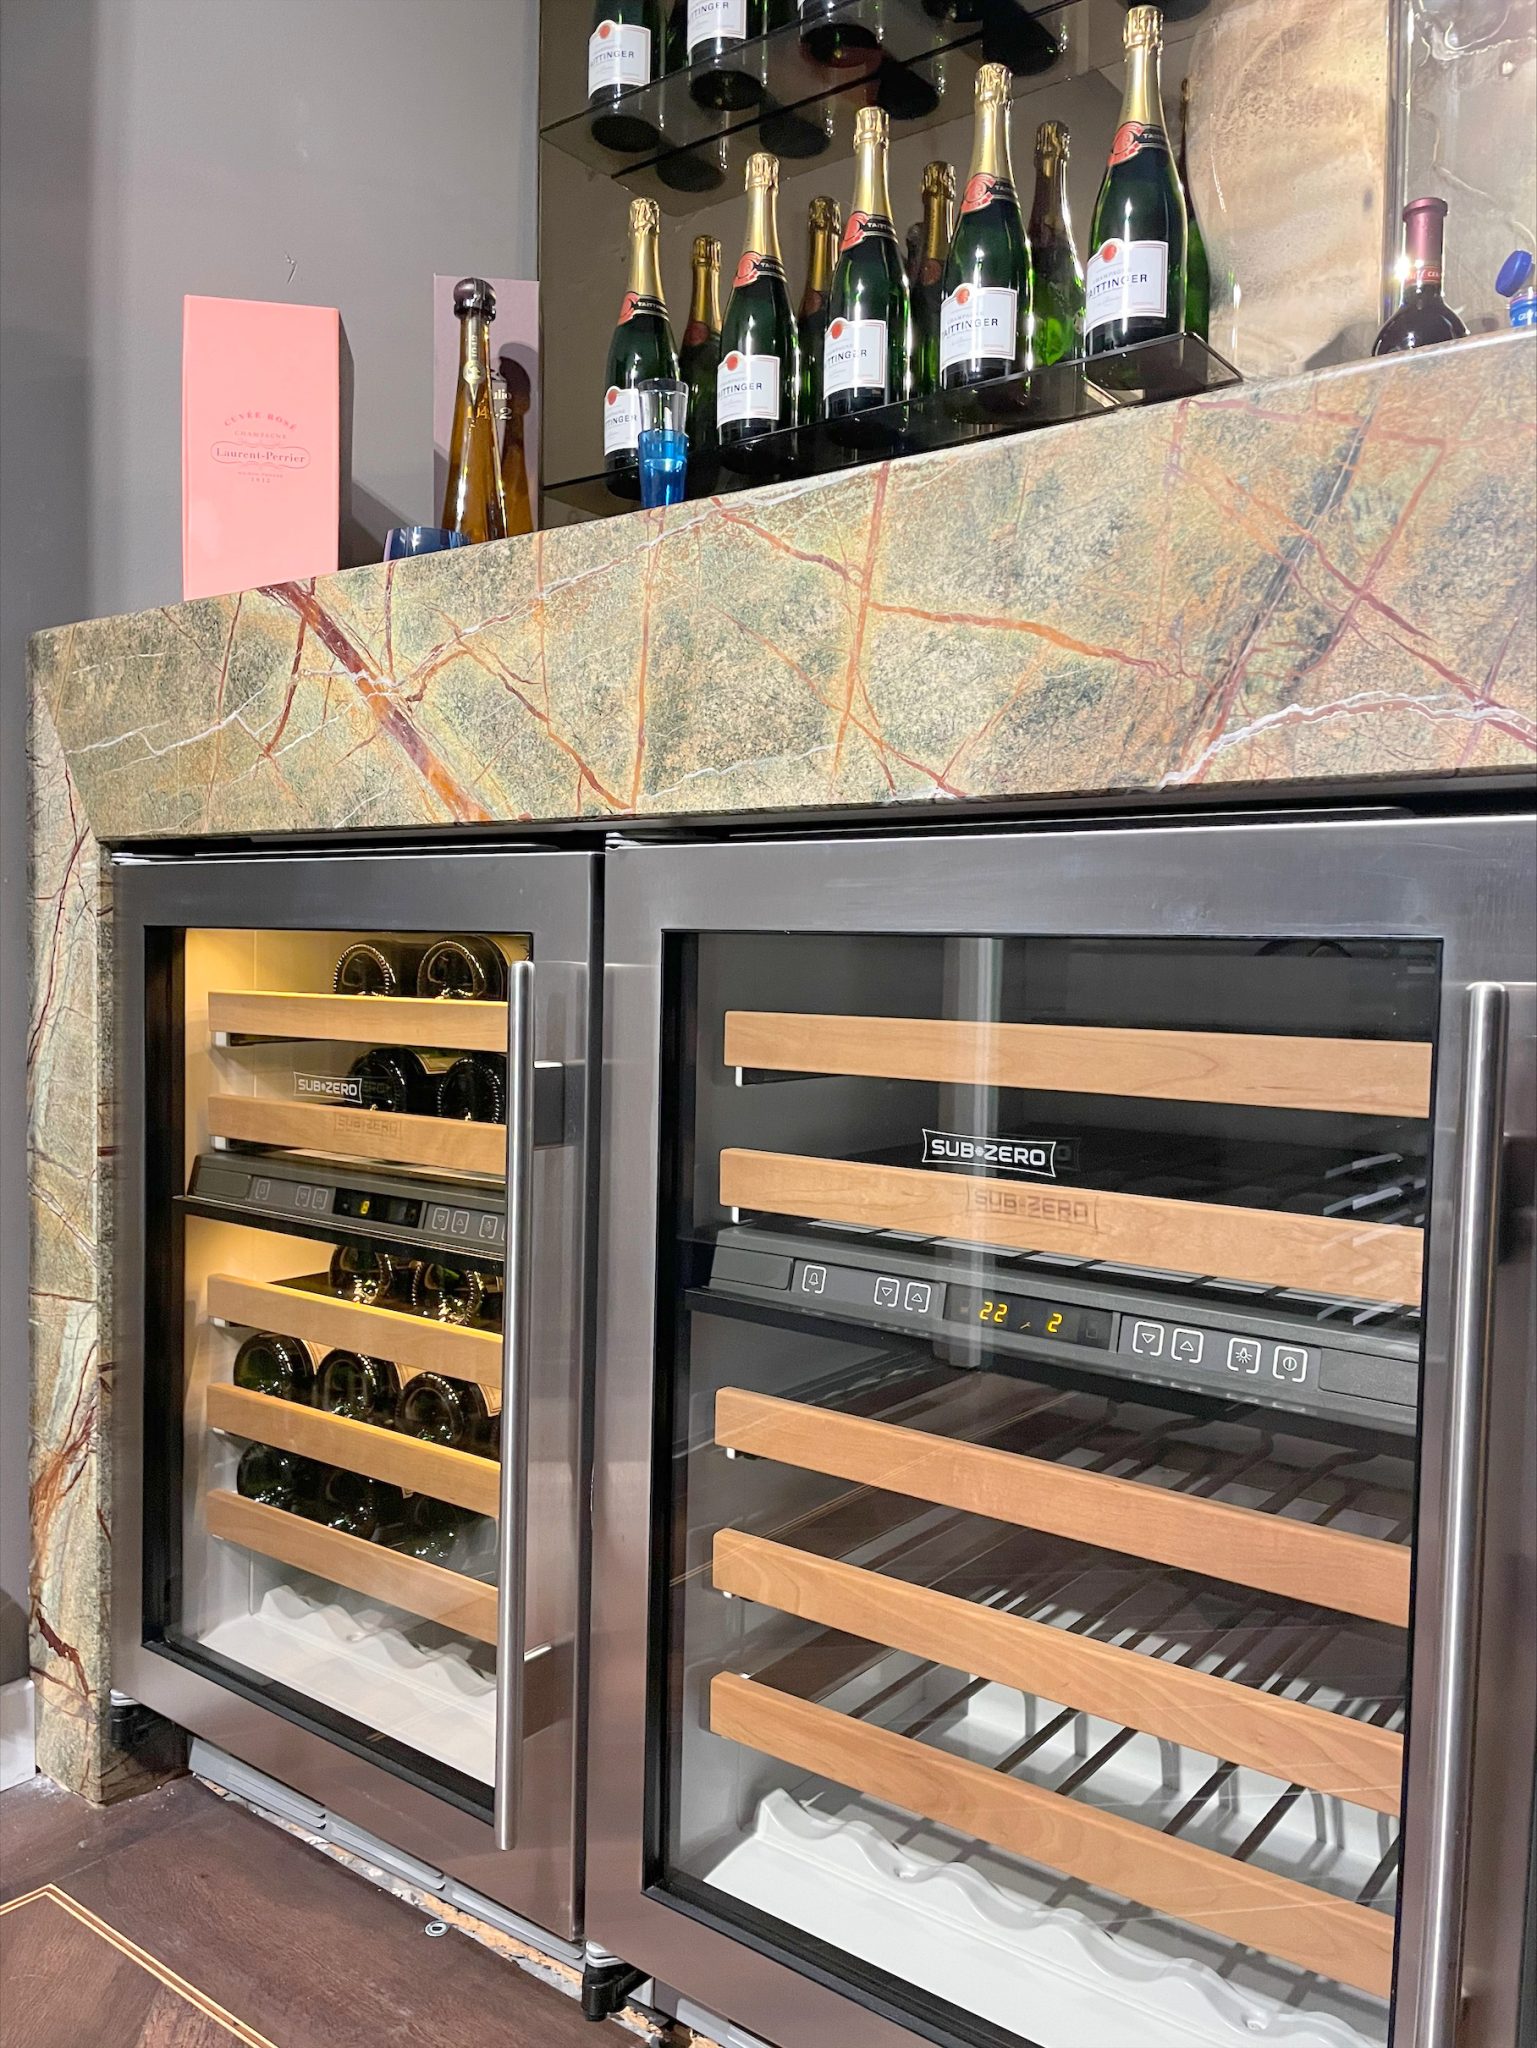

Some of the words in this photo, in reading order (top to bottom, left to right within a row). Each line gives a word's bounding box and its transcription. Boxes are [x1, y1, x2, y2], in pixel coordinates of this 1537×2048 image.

[216, 447, 305, 463] Laurent-Perrier
[979, 1301, 1009, 1323] 22
[1047, 1312, 1063, 1333] 2
